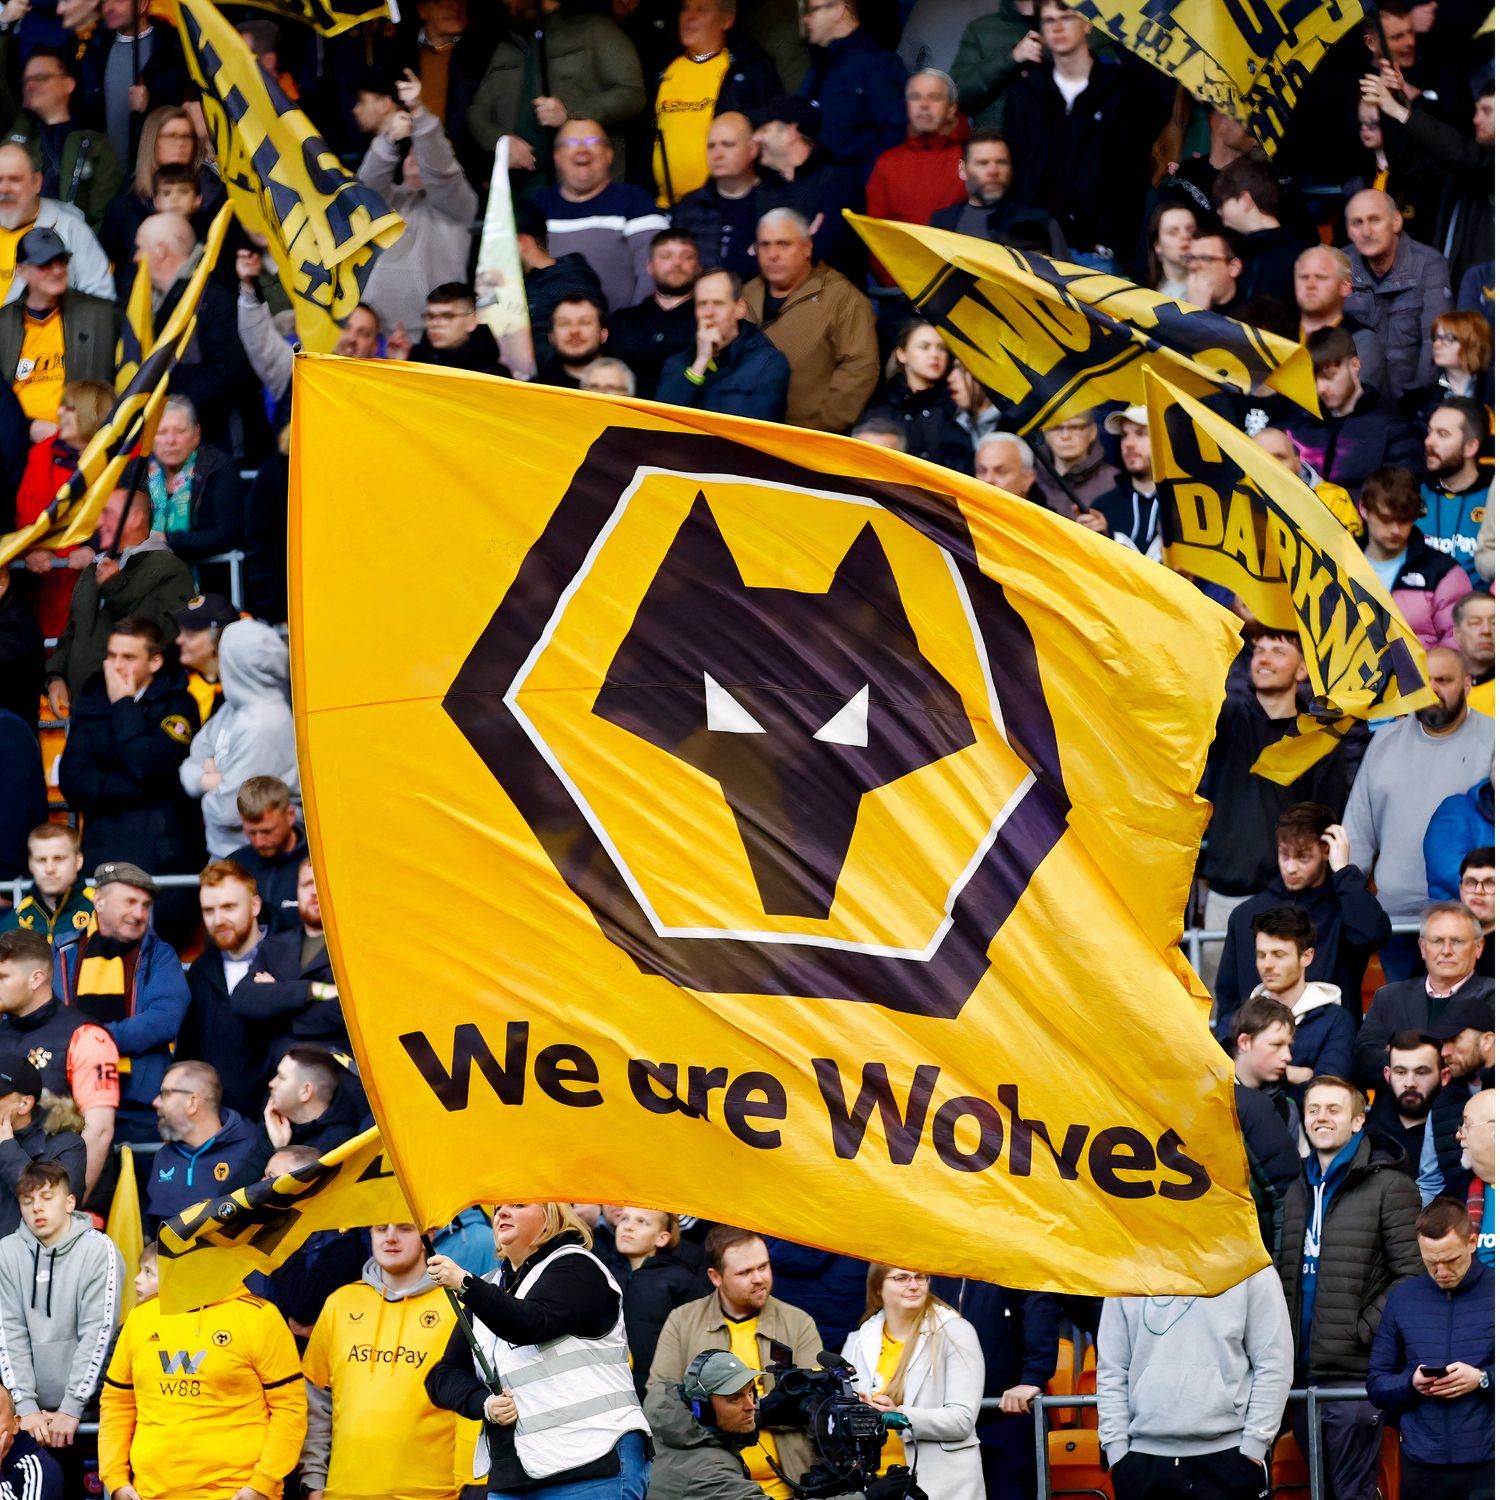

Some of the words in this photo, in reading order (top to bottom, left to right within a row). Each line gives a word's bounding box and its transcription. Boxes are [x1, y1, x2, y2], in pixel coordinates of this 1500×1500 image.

[398, 1020, 604, 1113] We
[627, 1058, 787, 1150] are
[811, 1057, 1213, 1201] Wolves
[159, 1380, 201, 1397] W88
